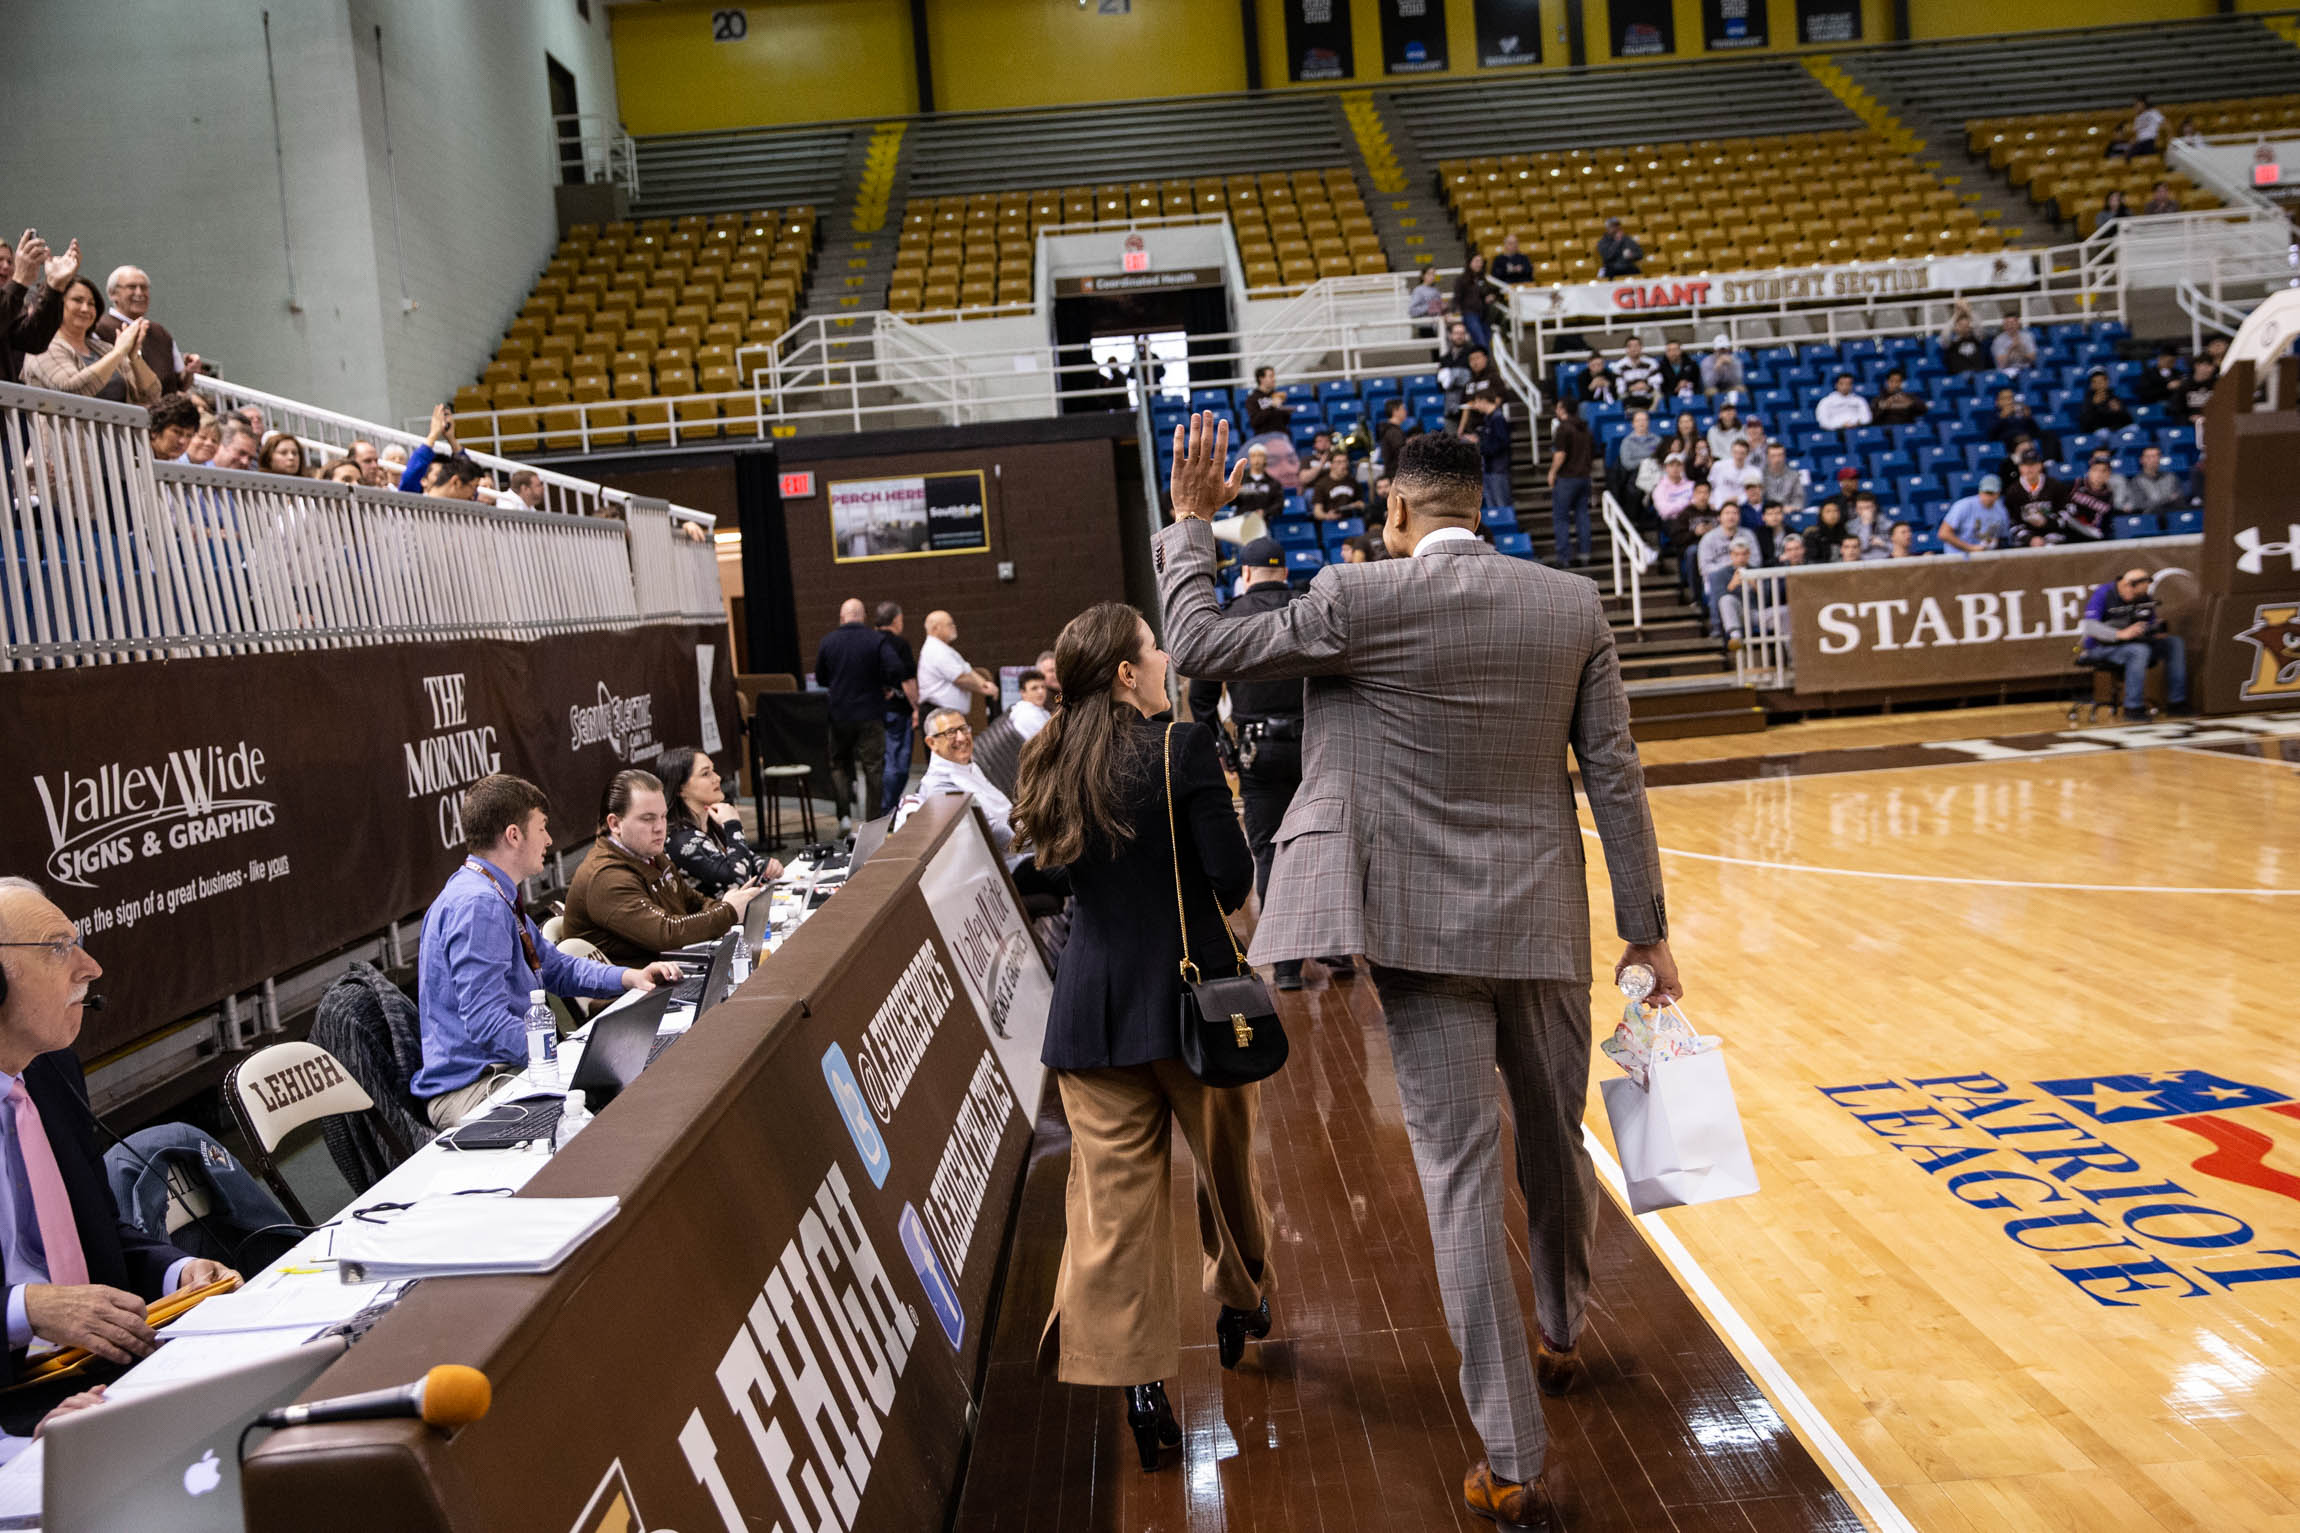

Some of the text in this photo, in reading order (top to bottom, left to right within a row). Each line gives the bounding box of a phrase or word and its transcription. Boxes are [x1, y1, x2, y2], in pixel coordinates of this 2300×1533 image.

[712, 11, 747, 41] 20
[1612, 267, 1929, 310] GIANT STUDENT SECTION
[831, 487, 926, 505] PERCH HERE
[1818, 584, 2101, 654] STABLE
[423, 673, 467, 729] THE
[34, 741, 266, 850] ValleyWide
[404, 726, 500, 798] MORNING
[56, 803, 276, 881] SIGNS & GRAPHICS
[93, 906, 113, 933] the
[115, 900, 141, 928] sign
[143, 890, 154, 916] of
[156, 893, 165, 911] a
[167, 879, 197, 914] great
[199, 868, 242, 899] business
[249, 859, 266, 882] like
[267, 854, 290, 881] yours
[858, 938, 954, 1124] @LEHIGHSPORTS
[248, 1054, 345, 1112] LEHIGH
[1814, 1079, 2211, 1307] LEAGUE
[1905, 1071, 2300, 1291] PATRIOT
